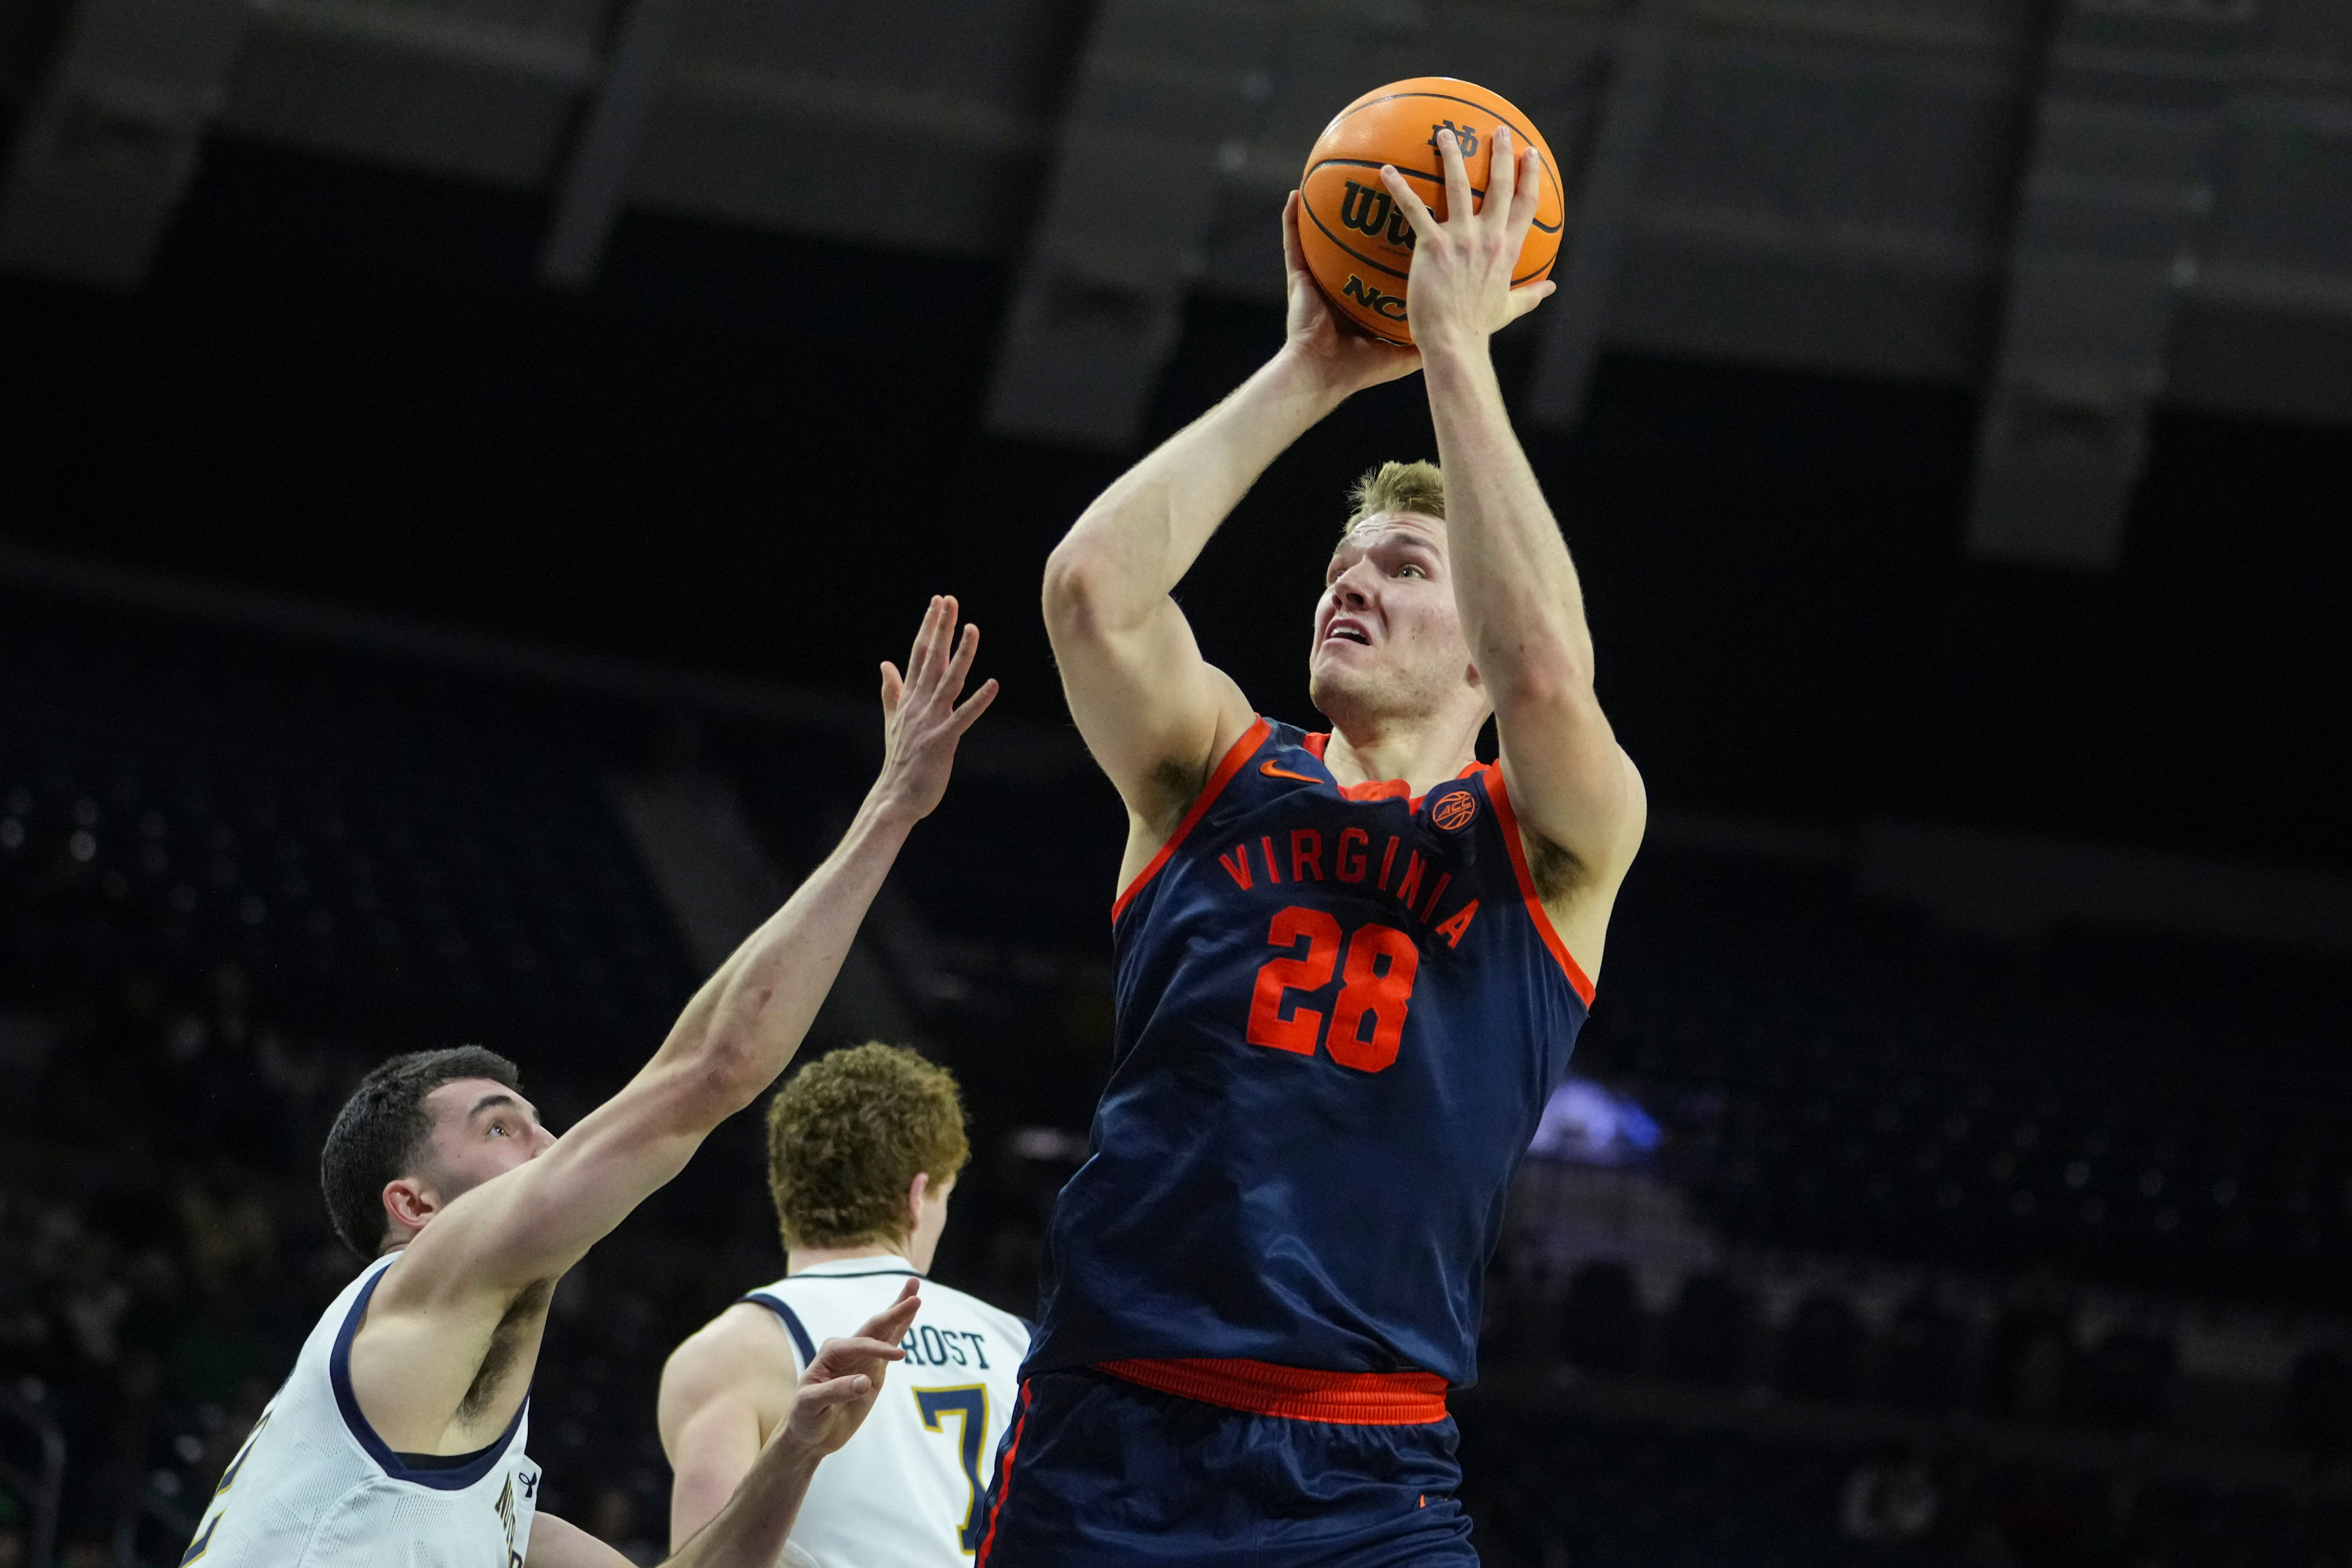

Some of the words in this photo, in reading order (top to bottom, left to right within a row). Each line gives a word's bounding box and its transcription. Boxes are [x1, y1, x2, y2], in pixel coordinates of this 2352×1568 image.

[1342, 273, 1408, 322] NC
[1438, 796, 1472, 819] ACC
[1218, 827, 1480, 948] VIRGINIA
[1246, 905, 1419, 1074] 28
[901, 1325, 990, 1369] ROST
[911, 1383, 990, 1555] 7
